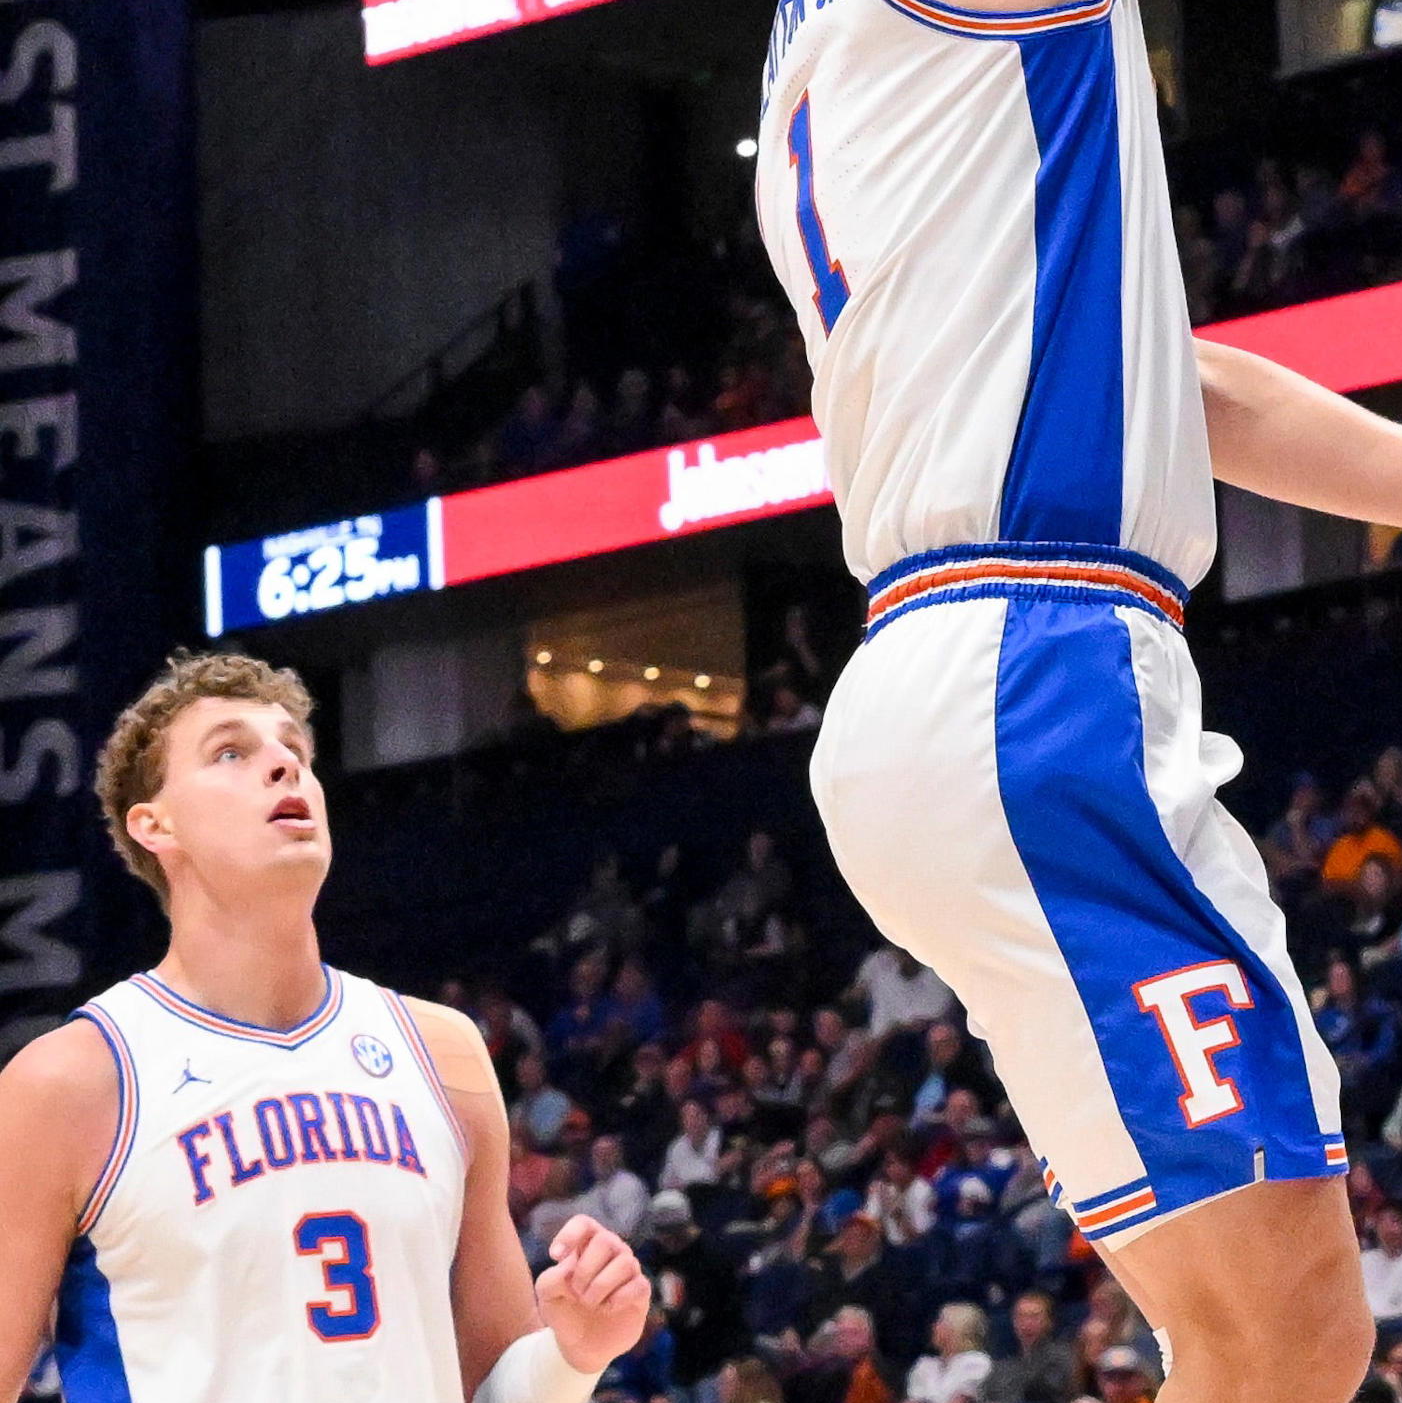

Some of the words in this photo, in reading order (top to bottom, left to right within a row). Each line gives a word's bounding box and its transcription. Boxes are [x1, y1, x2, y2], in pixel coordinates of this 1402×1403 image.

[787, 85, 852, 341] 1
[1131, 958, 1255, 1130] F
[177, 1091, 428, 1206] FLORIDA
[292, 1209, 381, 1344] 3
